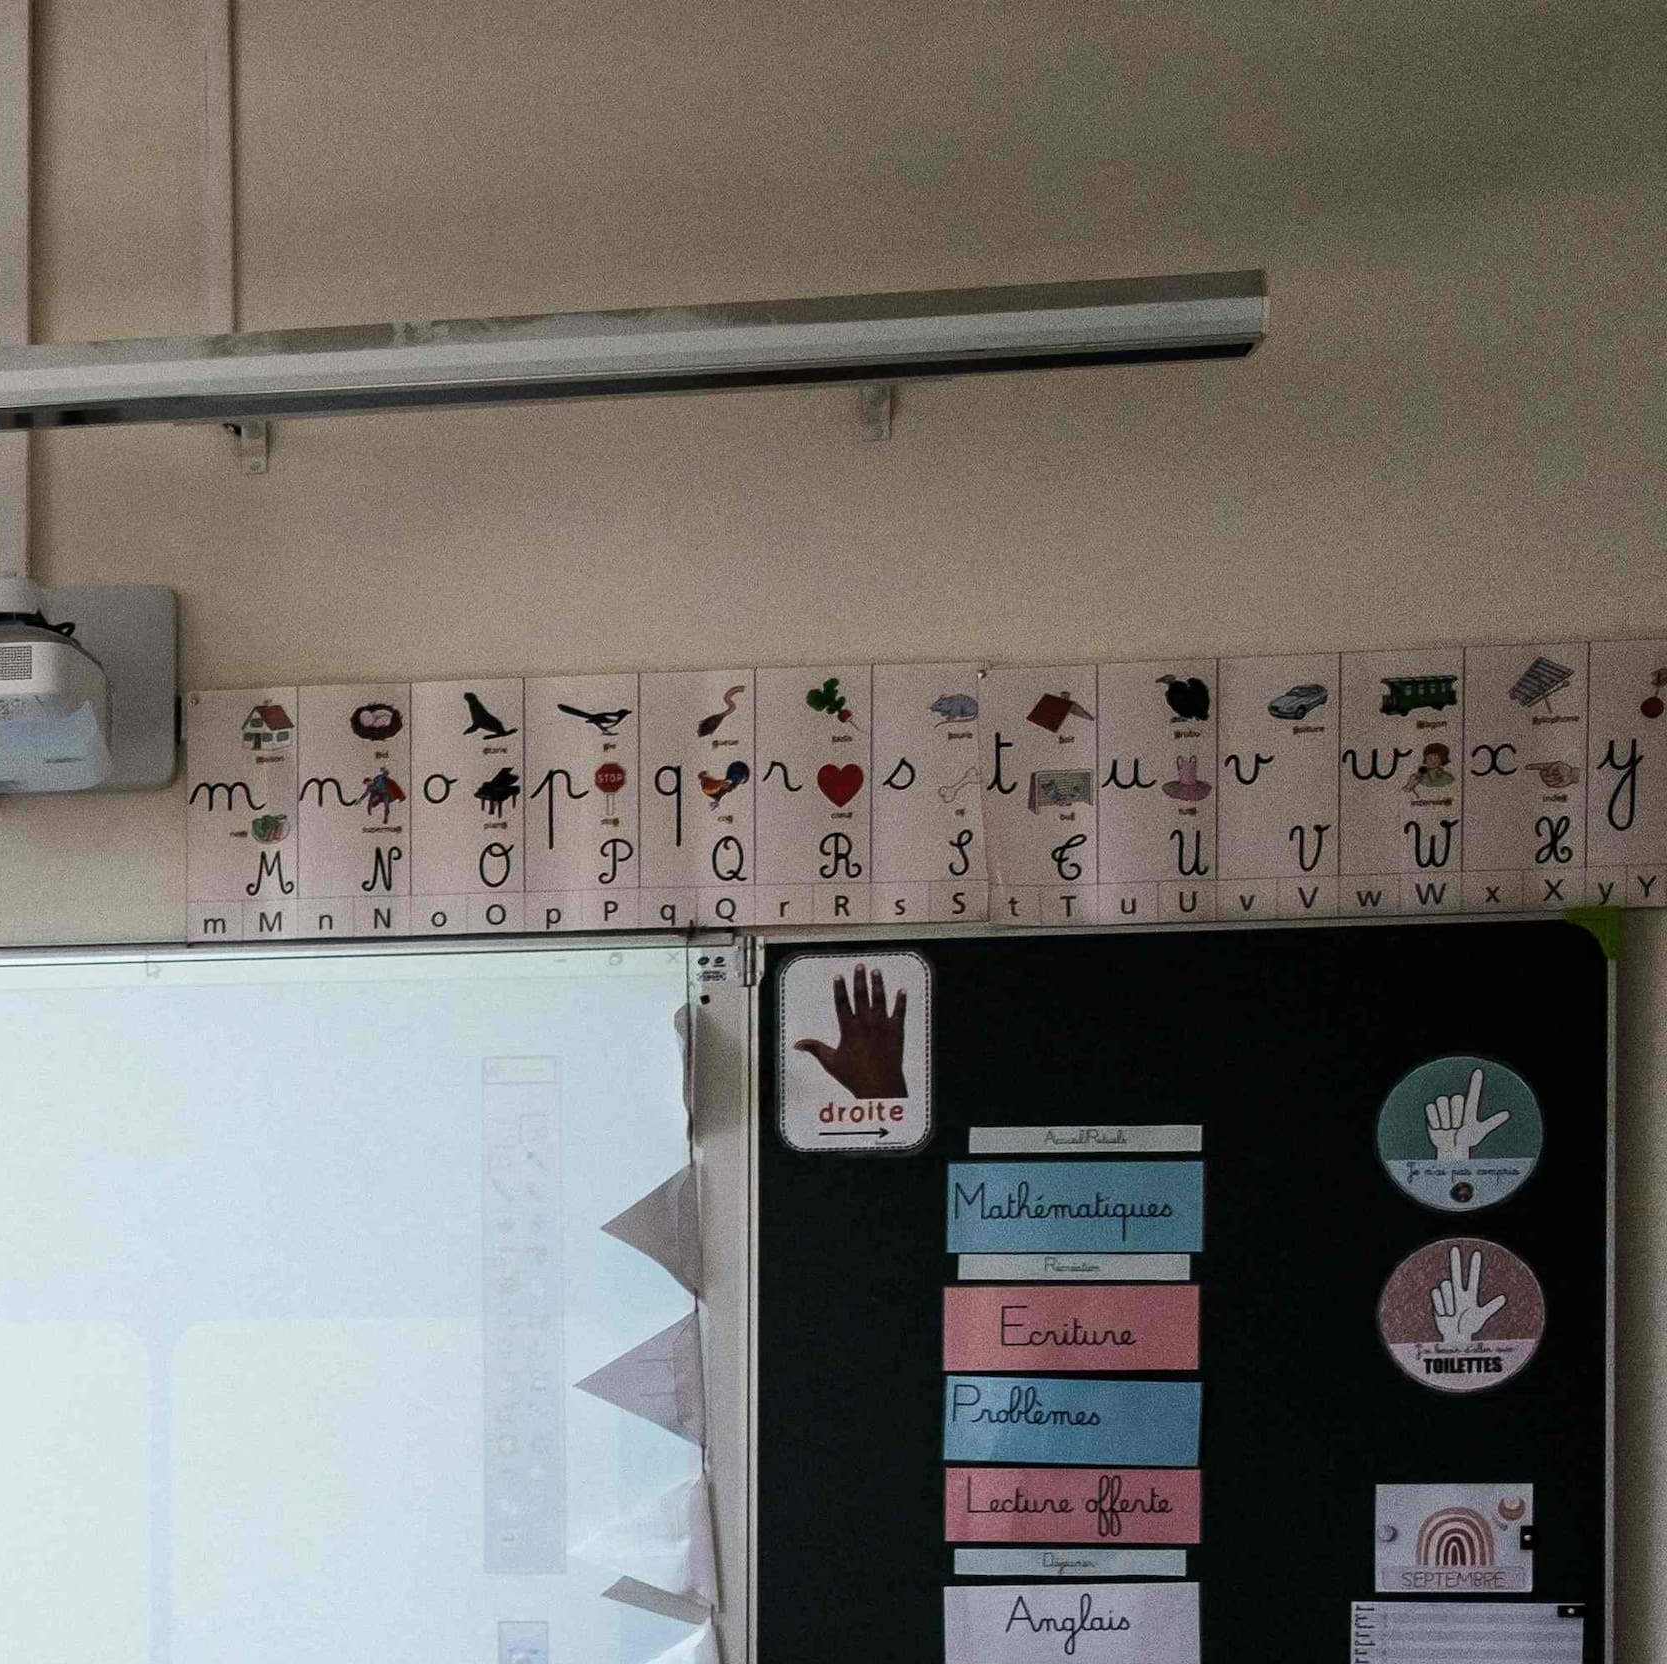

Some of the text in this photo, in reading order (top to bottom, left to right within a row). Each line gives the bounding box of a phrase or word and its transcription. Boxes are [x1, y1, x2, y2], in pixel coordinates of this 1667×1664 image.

[188, 731, 1645, 850] m n o p q r s t u v w x y
[597, 773, 623, 783] STOP
[258, 875, 1657, 933] M N O P Q R S T U V W X Y
[819, 1102, 903, 1123] droite
[955, 1181, 1174, 1242] Mathématiques
[1001, 1305, 1137, 1346] Ecriture
[1424, 1357, 1502, 1374] TOILETTES
[952, 1384, 1101, 1426] Problèmes
[967, 1475, 1173, 1537] Lecture offerte
[1401, 1571, 1507, 1589] SEPTEMBRE
[1006, 1593, 1130, 1655] Anglais
